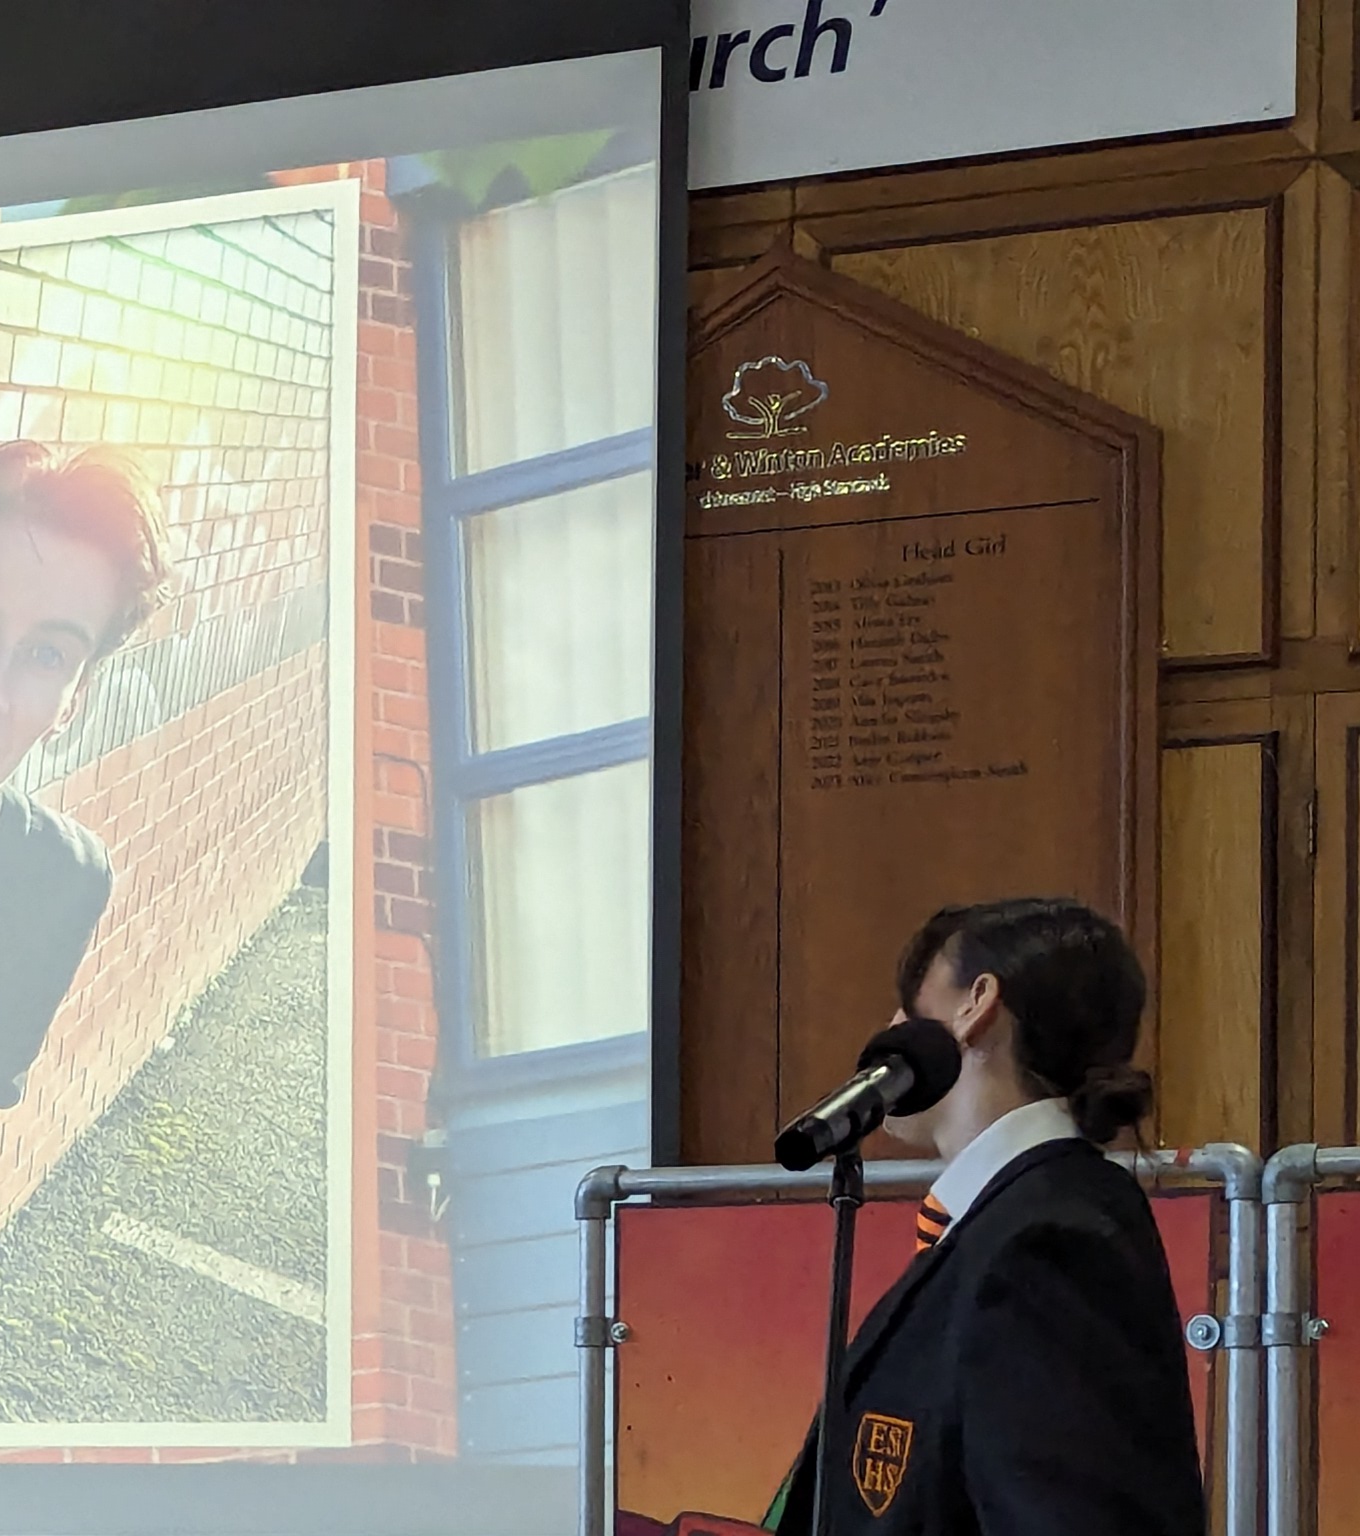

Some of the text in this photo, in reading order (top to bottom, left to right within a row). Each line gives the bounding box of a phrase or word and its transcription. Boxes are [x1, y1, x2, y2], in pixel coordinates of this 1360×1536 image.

[710, 453, 732, 479] &
[734, 448, 825, 477] Winton
[827, 430, 968, 469] Academies
[902, 533, 1007, 562] Head Girl
